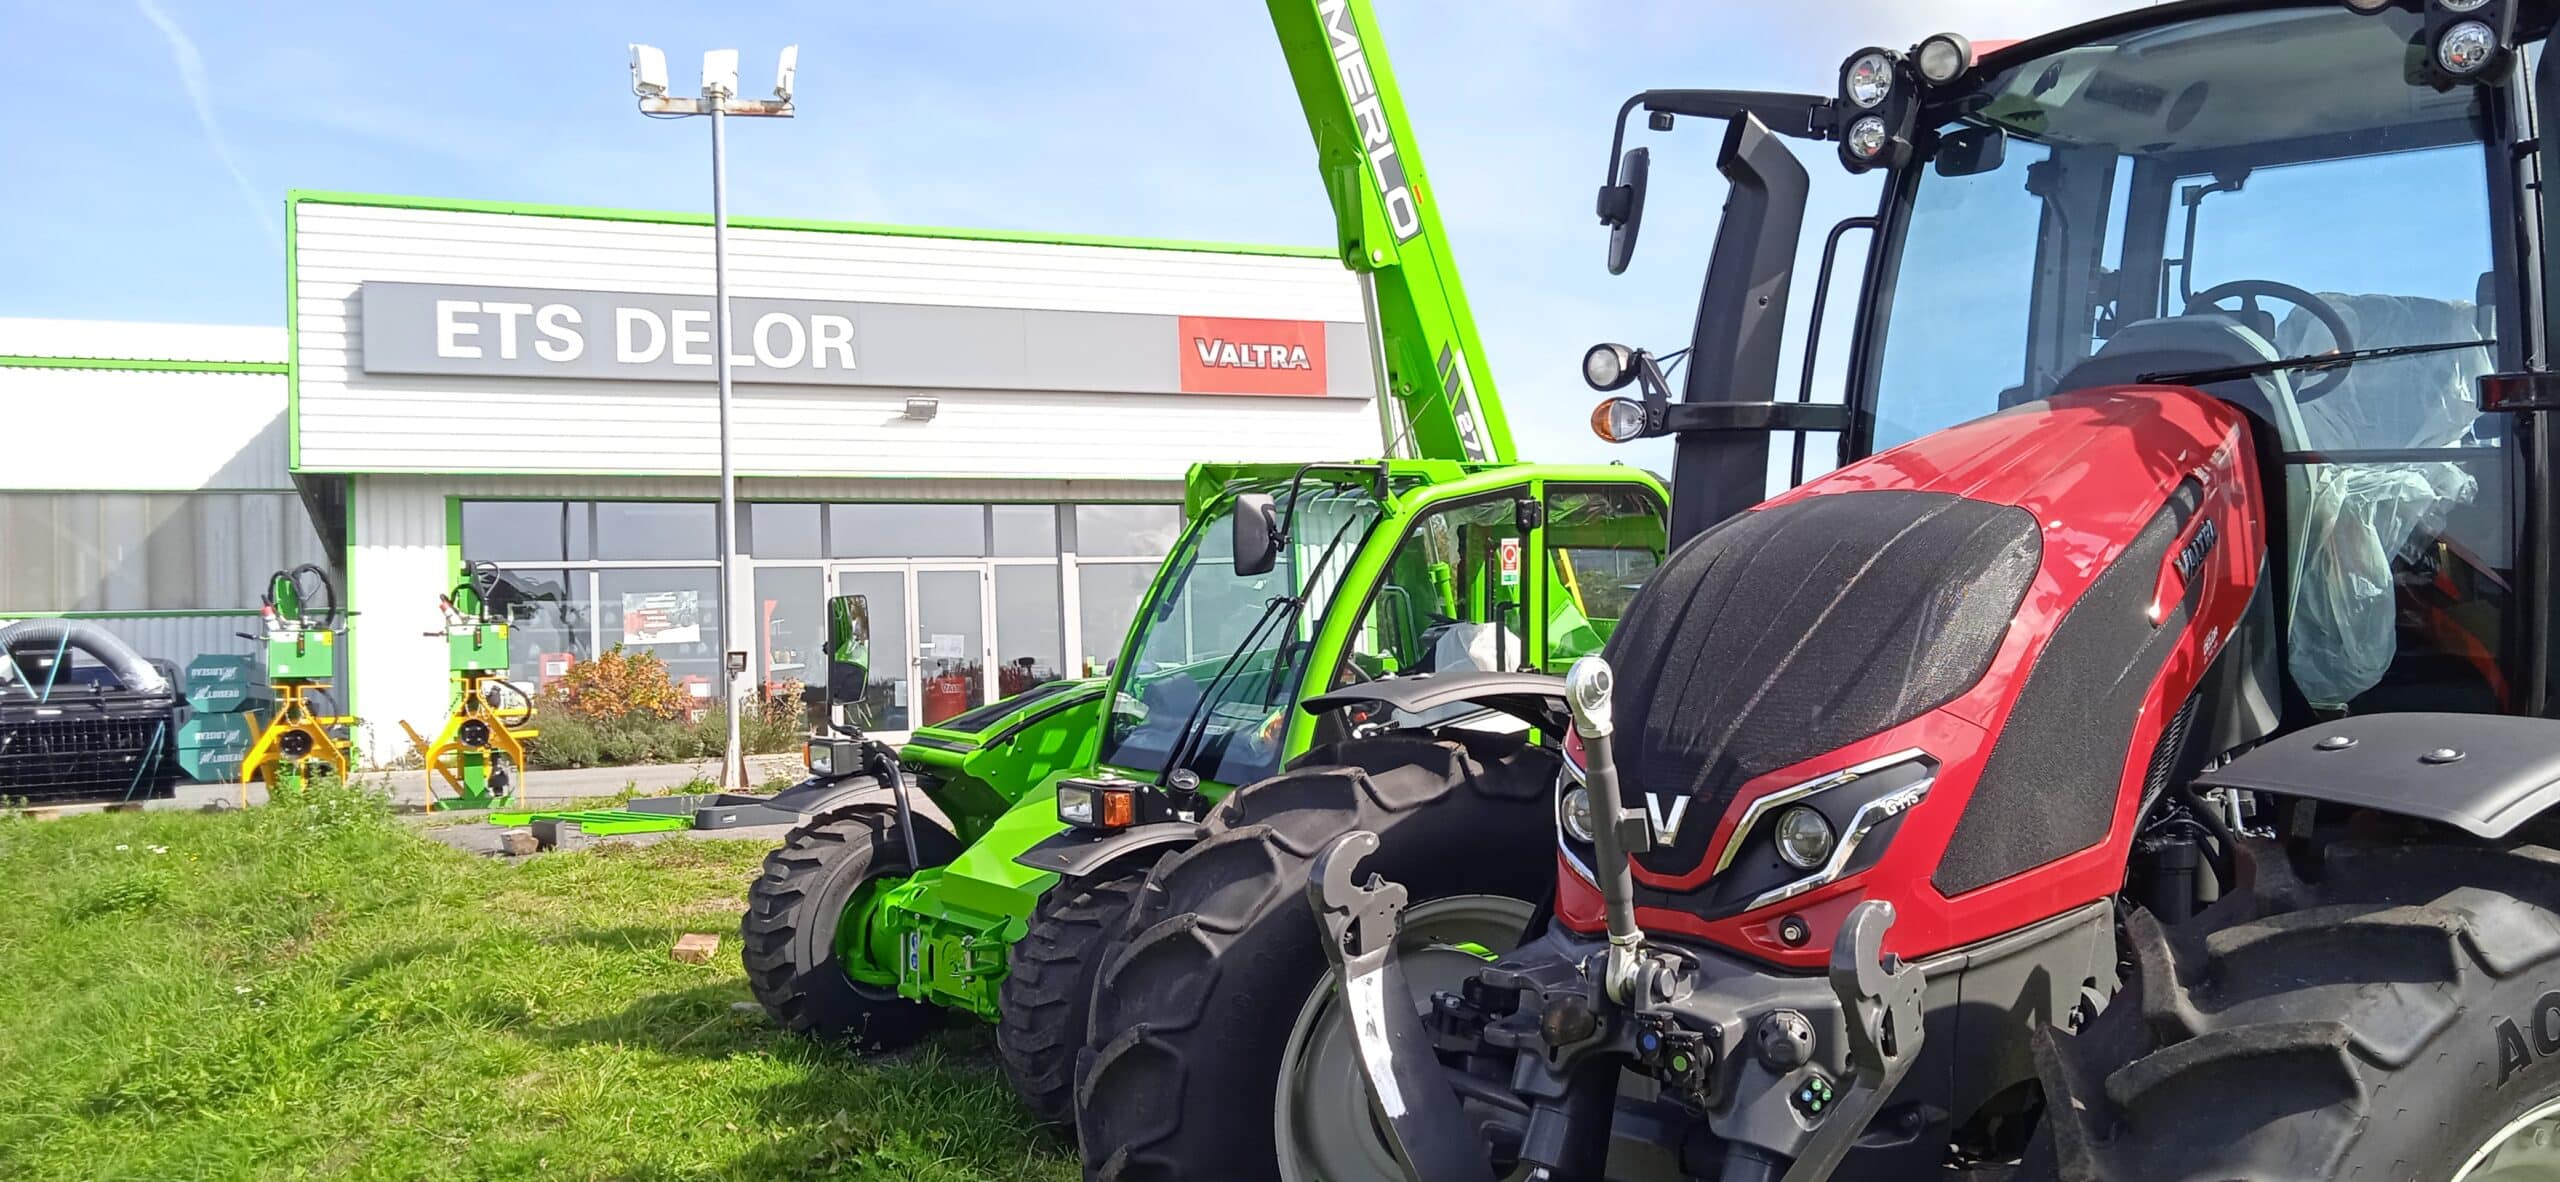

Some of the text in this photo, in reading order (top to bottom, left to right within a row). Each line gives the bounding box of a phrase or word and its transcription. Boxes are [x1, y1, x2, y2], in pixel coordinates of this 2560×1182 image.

[1318, 0, 1420, 239] MERLO
[435, 299, 584, 362] ETS
[1194, 337, 1312, 370] VALTRA
[1645, 791, 1691, 847] V
